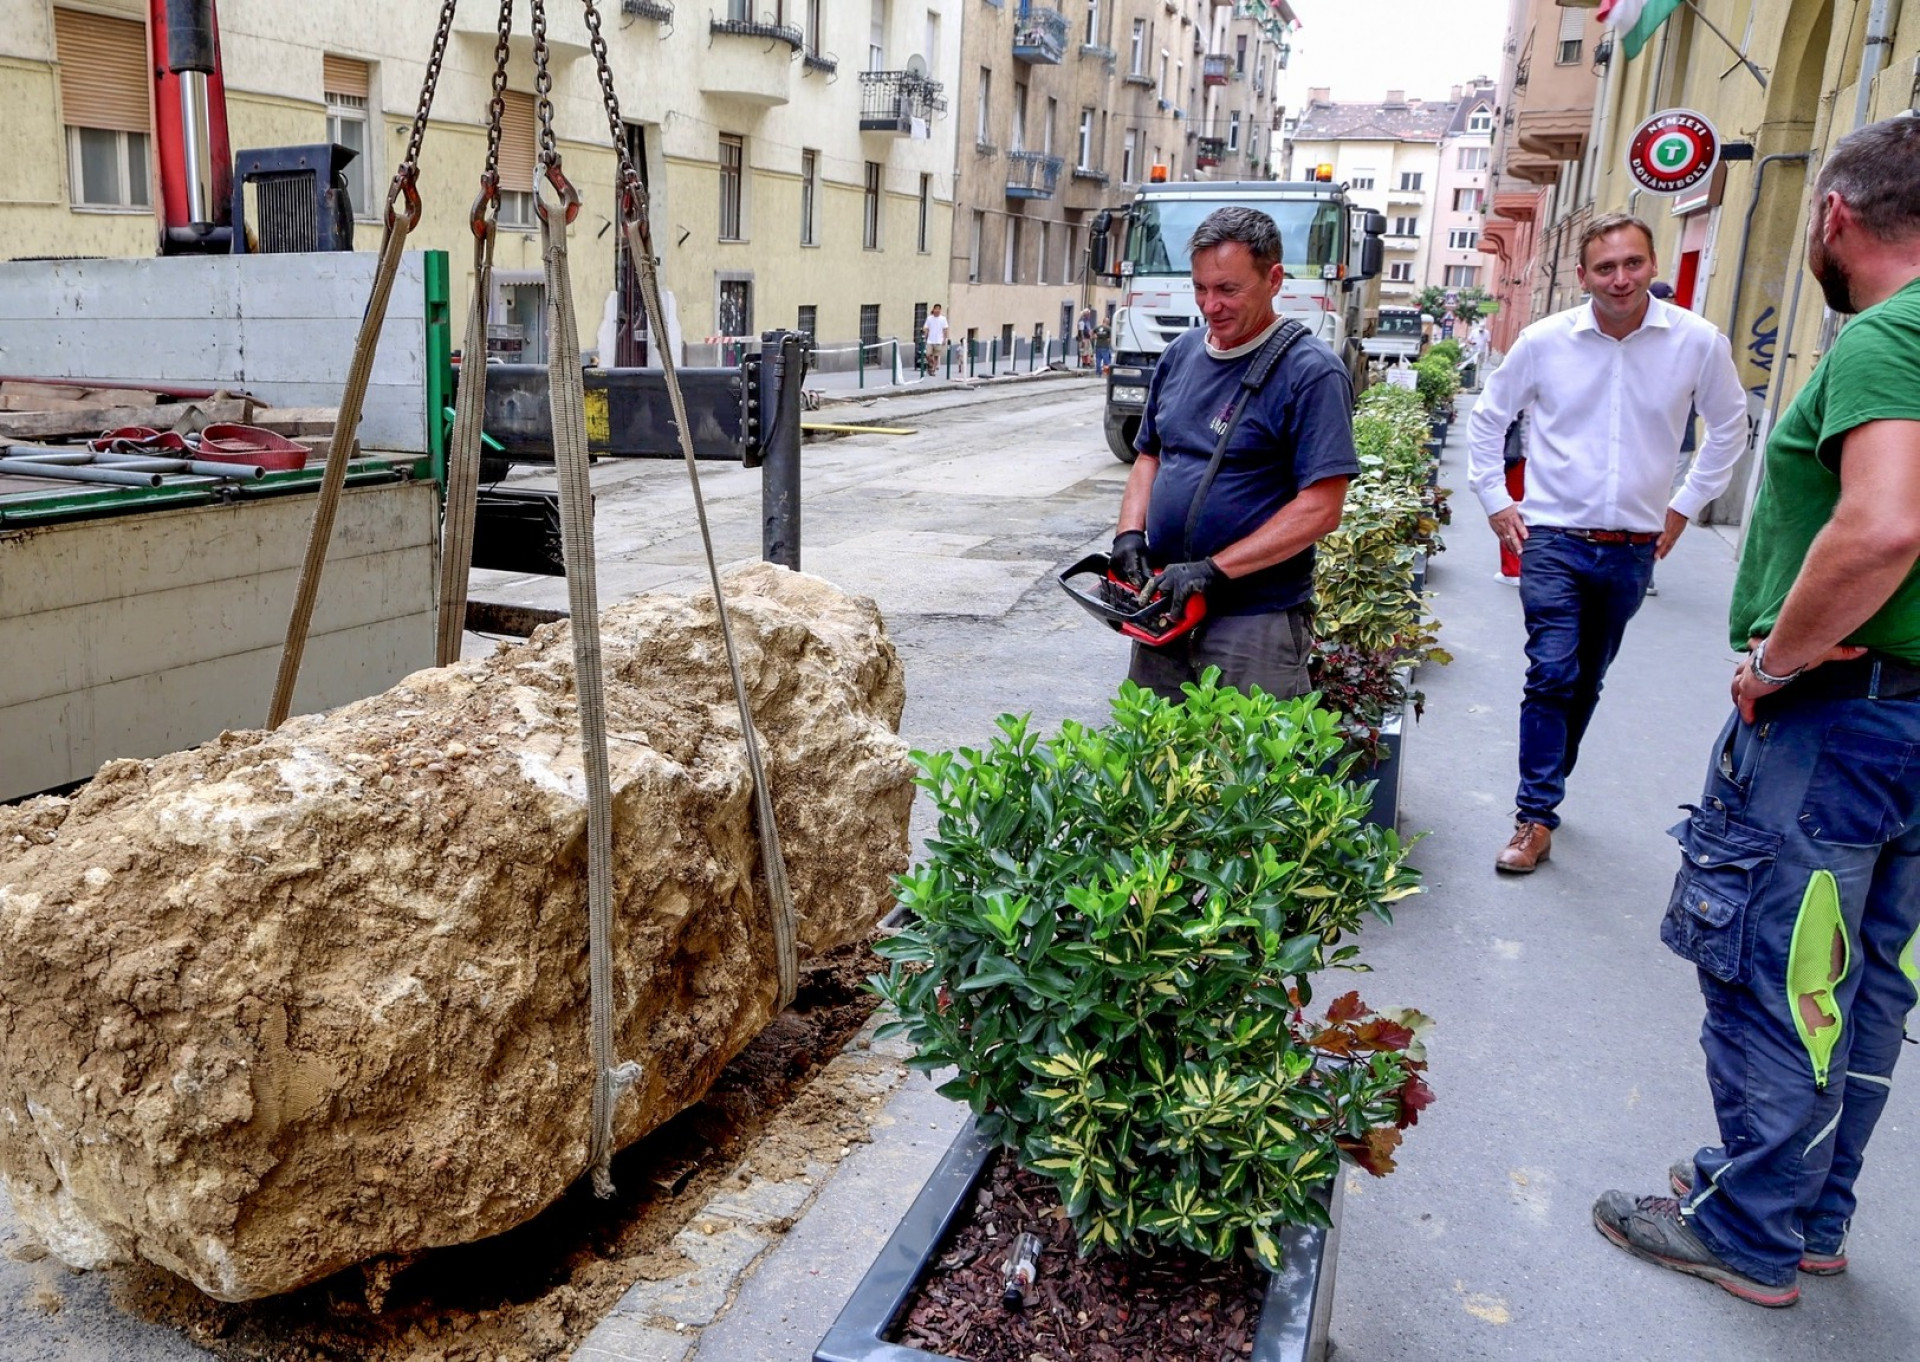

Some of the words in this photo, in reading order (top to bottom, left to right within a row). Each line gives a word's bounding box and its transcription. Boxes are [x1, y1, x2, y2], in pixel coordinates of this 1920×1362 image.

[1647, 117, 1707, 136] NEMZETI
[1665, 145, 1682, 161] T
[1632, 158, 1708, 190] DOHÁNYBOLT
